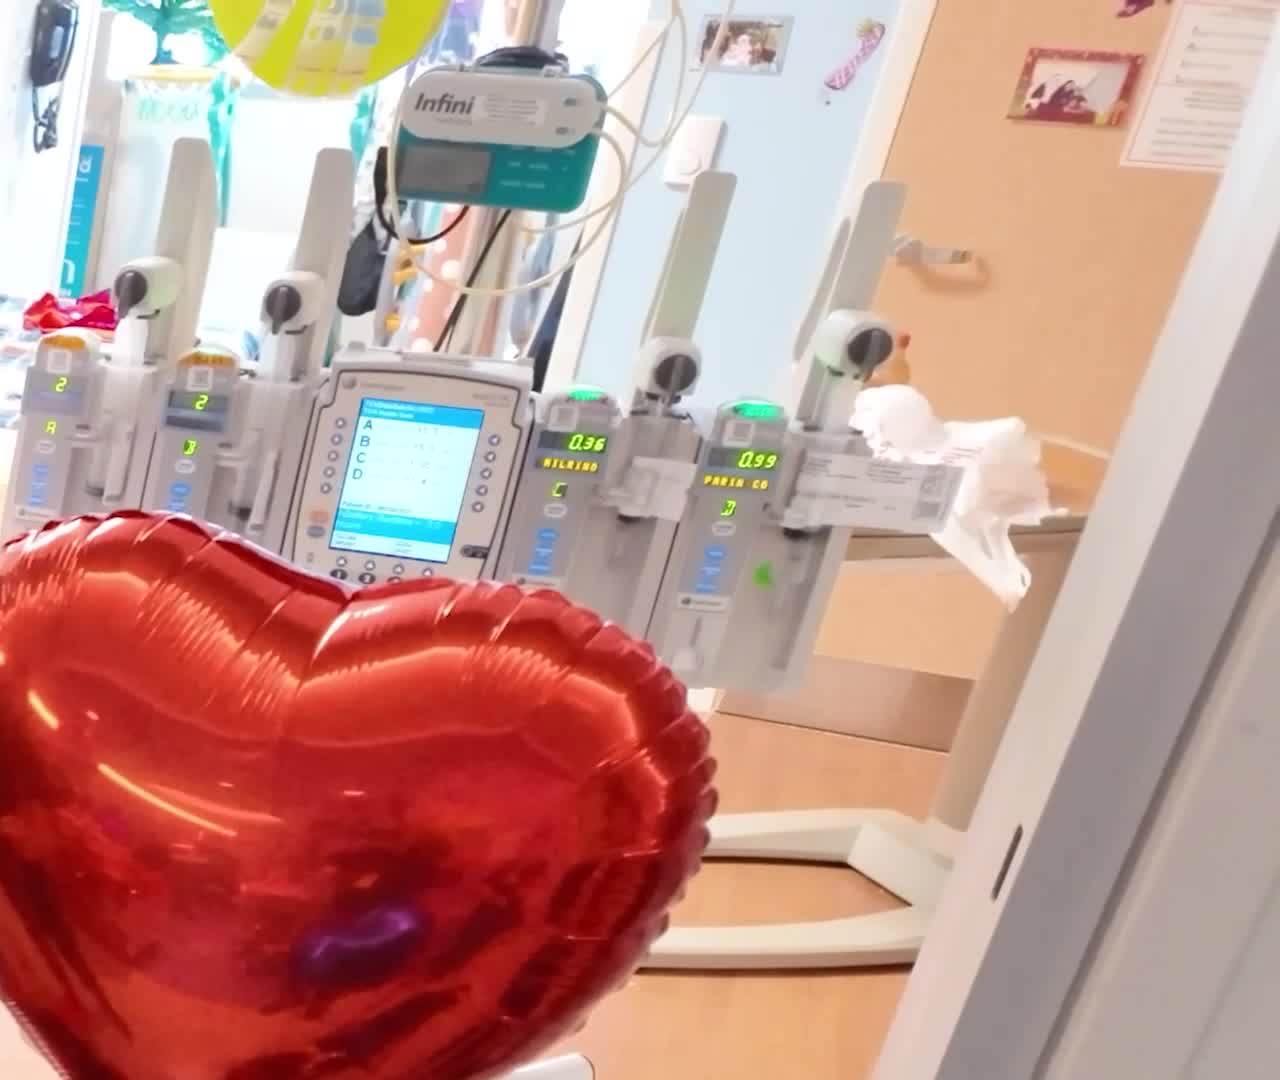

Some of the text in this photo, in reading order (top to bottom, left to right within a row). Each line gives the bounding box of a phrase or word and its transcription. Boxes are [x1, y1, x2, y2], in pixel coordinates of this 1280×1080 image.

[55, 377, 68, 392] 2
[195, 395, 209, 410] 2
[360, 436, 371, 447] B
[568, 434, 606, 451] 0.36
[738, 451, 777, 468] 0.99
[352, 468, 363, 480] D
